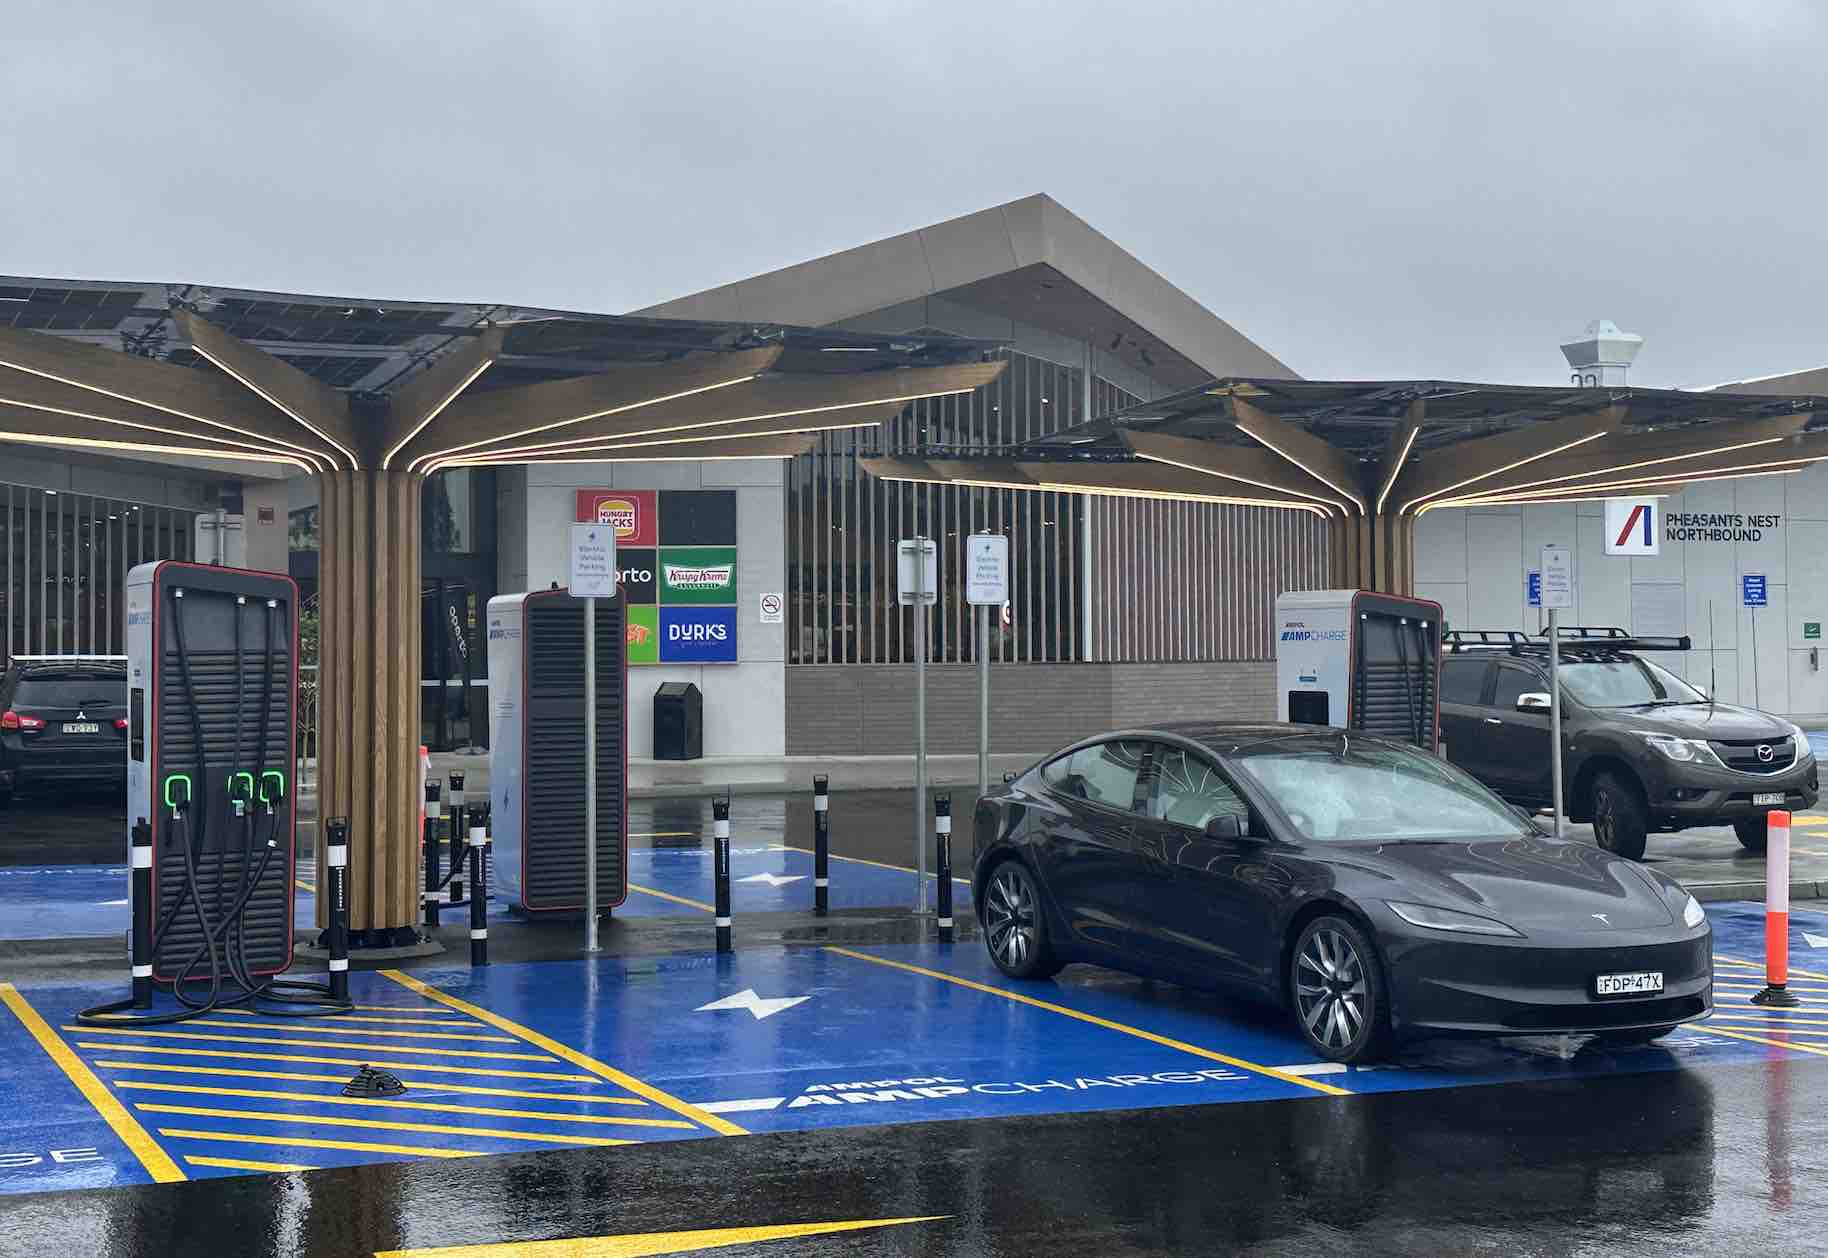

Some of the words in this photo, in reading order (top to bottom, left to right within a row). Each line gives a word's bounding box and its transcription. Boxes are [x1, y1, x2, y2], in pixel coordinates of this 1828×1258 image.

[1666, 513, 1743, 528] PHEASANTS
[1747, 515, 1781, 528] NEST
[1666, 528, 1762, 542] NORTHBOUND
[787, 1067, 1249, 1108] AMPCHARGE
[805, 1075, 966, 1093] AMPOL
